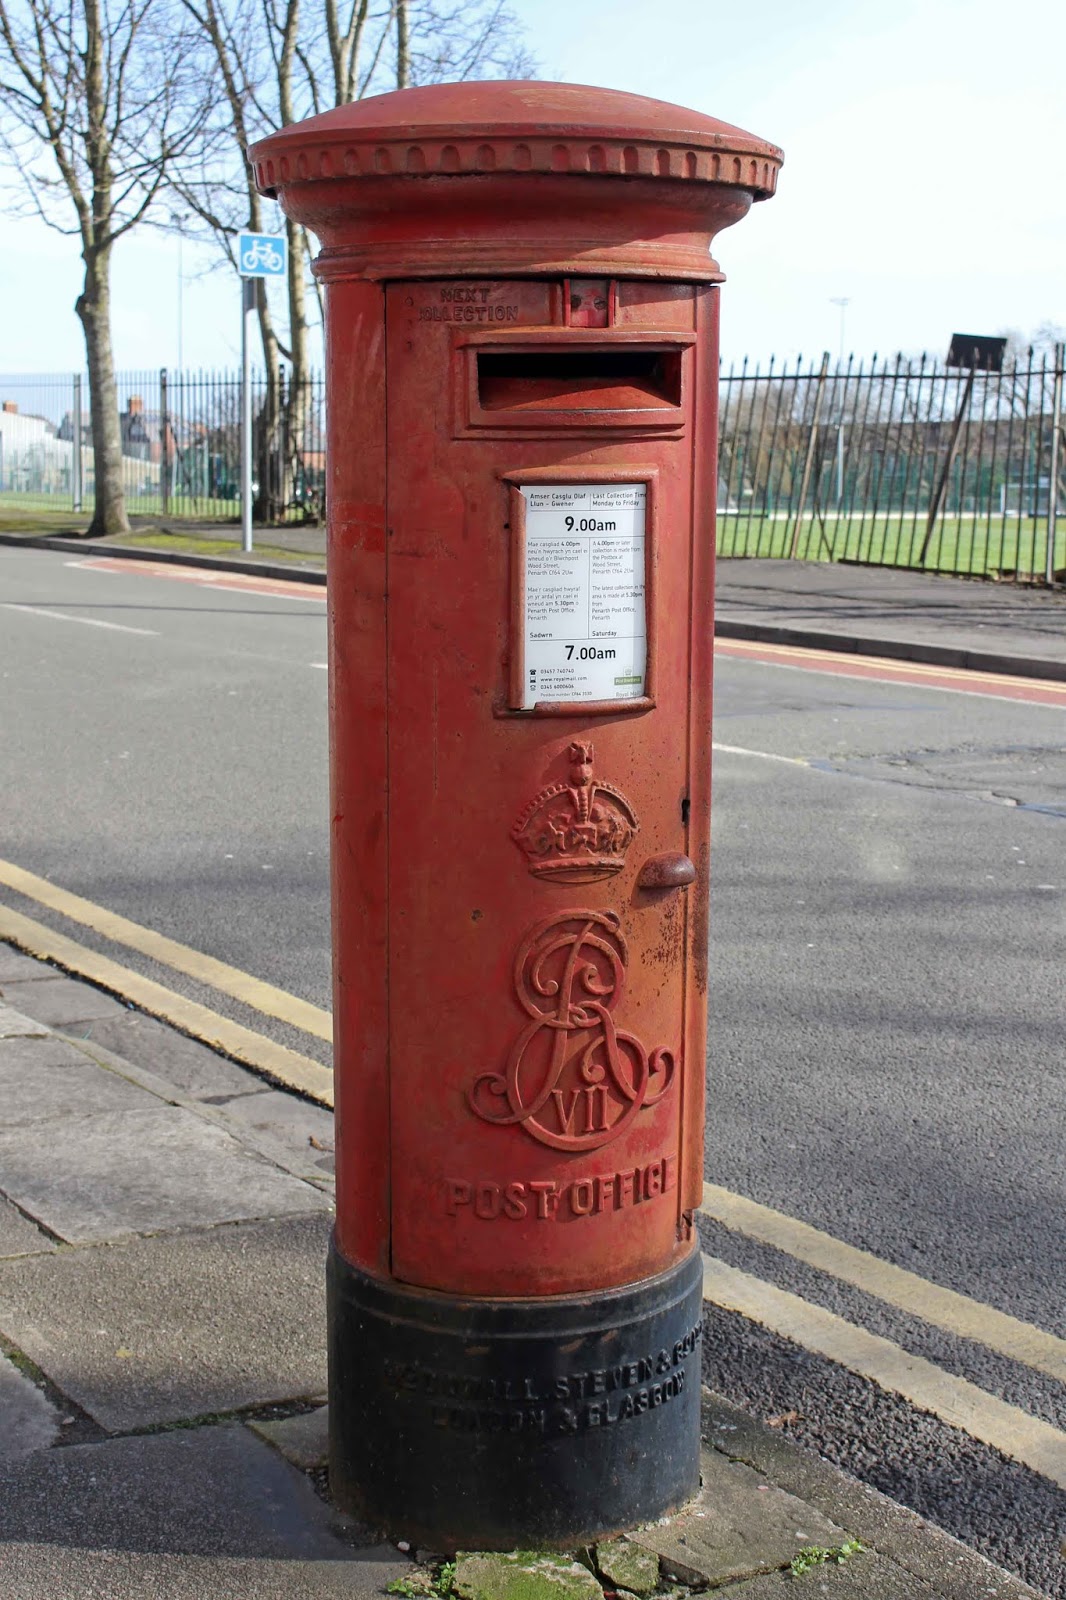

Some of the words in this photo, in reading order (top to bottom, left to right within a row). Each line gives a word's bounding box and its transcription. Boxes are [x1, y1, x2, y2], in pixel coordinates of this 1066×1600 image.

[441, 288, 490, 303] NEXT
[551, 493, 572, 501] Casglu
[565, 516, 616, 531] 9.00am
[565, 645, 616, 660] 7.00am
[551, 1088, 612, 1136] VII
[443, 1176, 556, 1221] POST
[555, 1355, 653, 1399] STEVEN
[656, 1349, 672, 1375] &
[586, 1367, 686, 1427] GLASGOW
